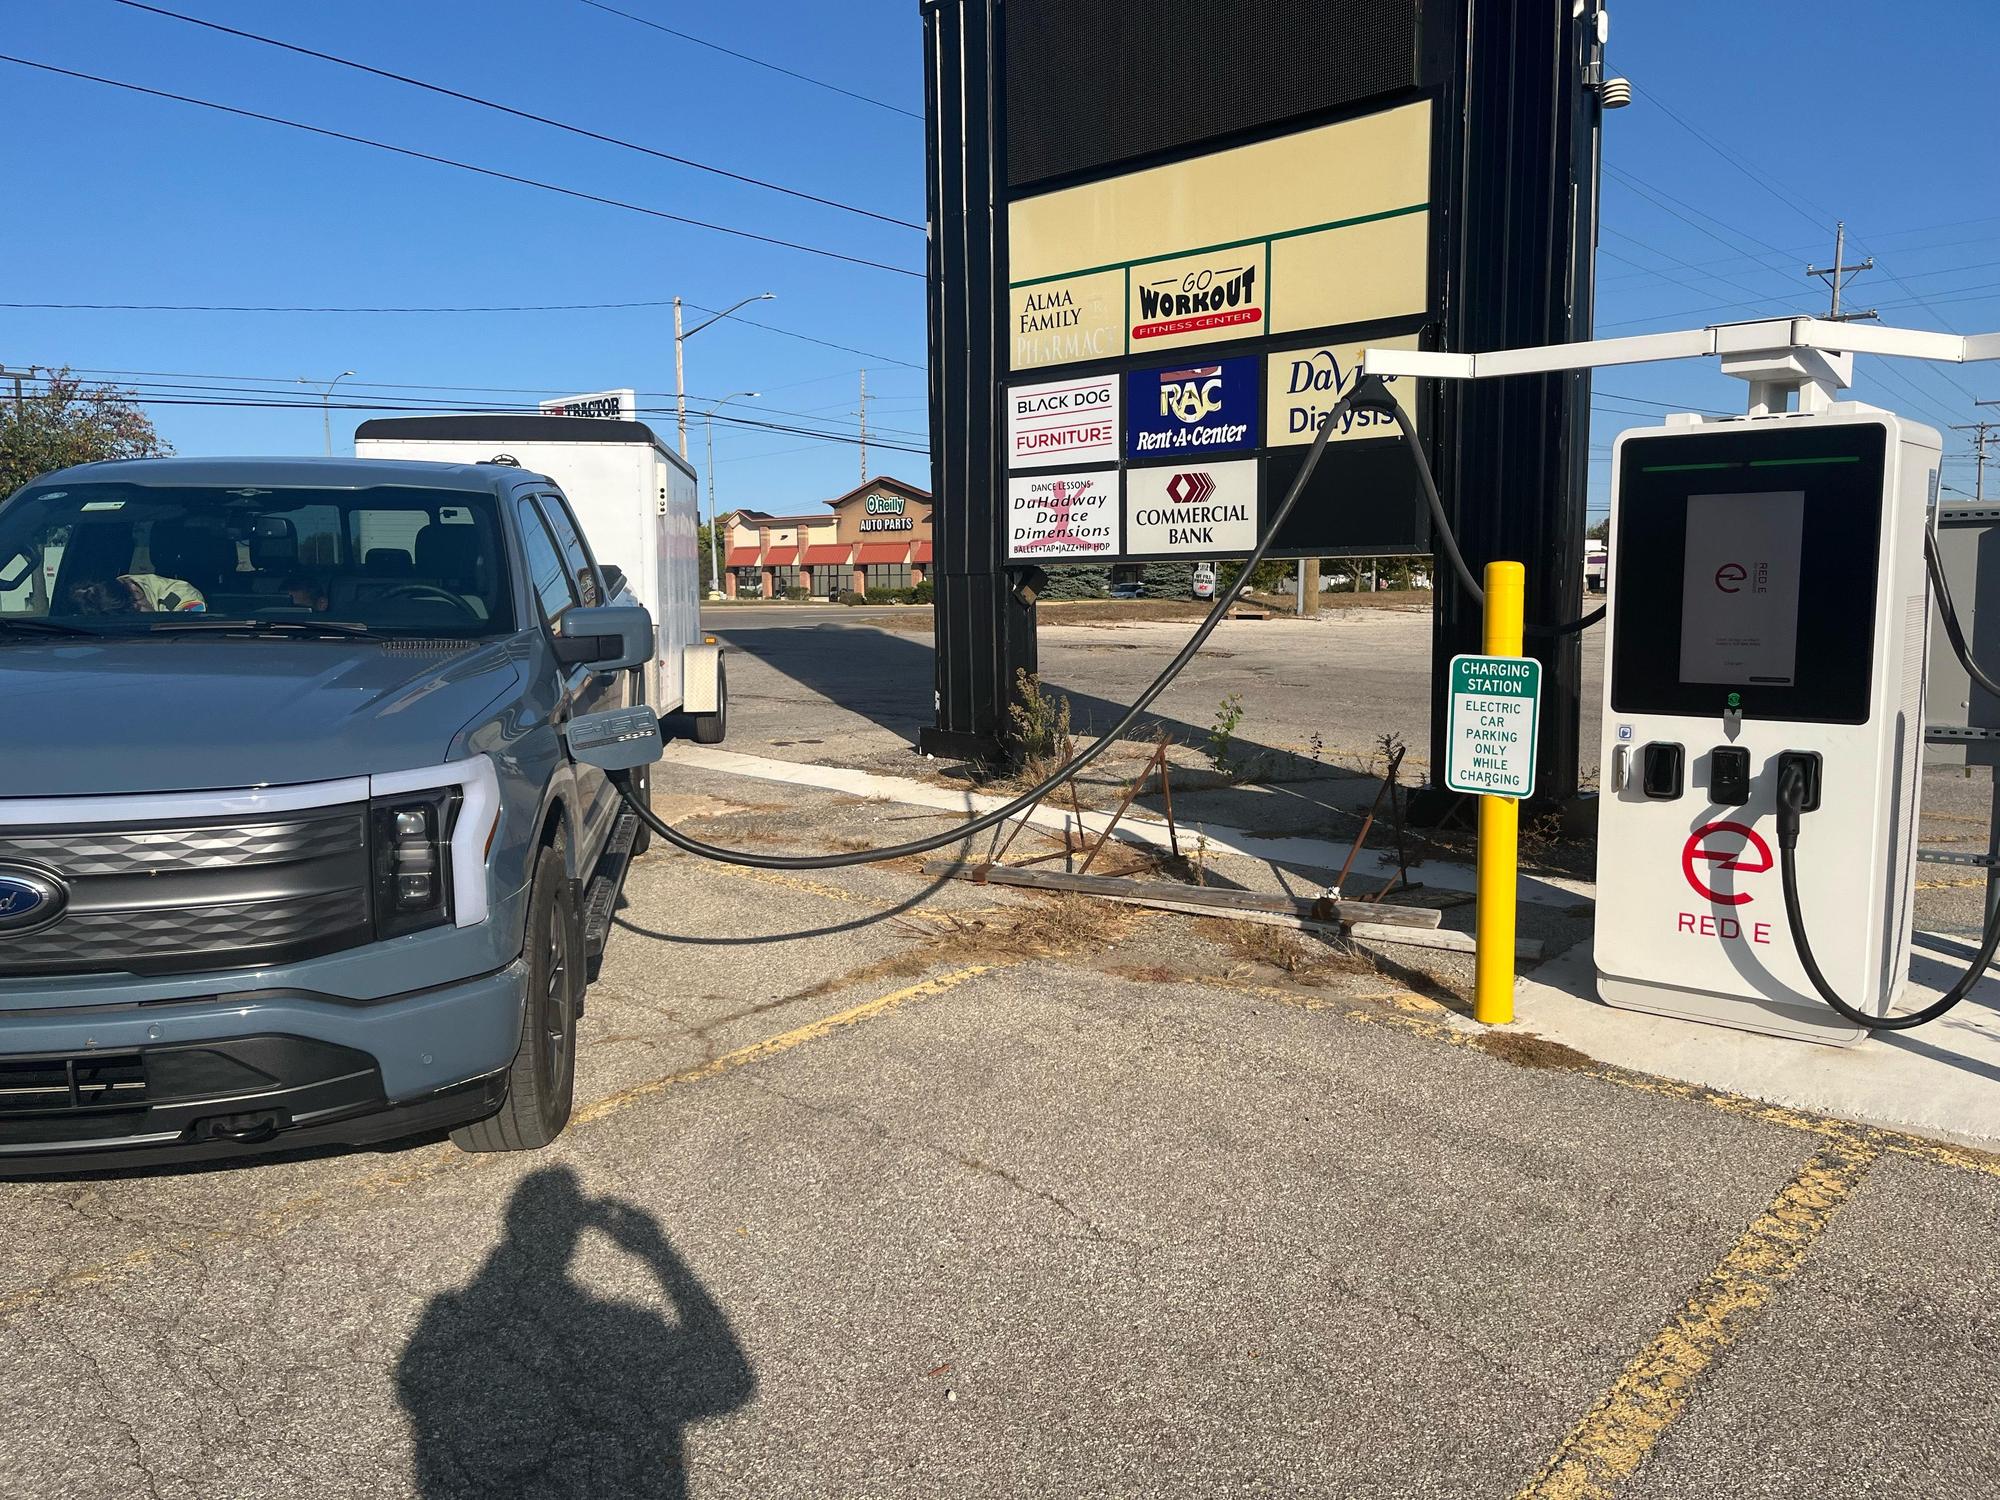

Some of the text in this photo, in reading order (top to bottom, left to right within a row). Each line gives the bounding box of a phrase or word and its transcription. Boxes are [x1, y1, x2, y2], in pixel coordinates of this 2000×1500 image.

[1182, 269, 1212, 293] GO
[1024, 289, 1073, 313] ALMA
[1139, 265, 1255, 320] WORKOUT
[1020, 308, 1082, 334] FAMILY
[1140, 312, 1251, 336] FITNESS CENTER
[564, 397, 621, 418] TRACTOR
[1017, 389, 1110, 414] BLACK DOG
[1160, 378, 1222, 424] RAC
[1017, 426, 1112, 450] FURNITURE
[866, 494, 905, 515] O'Reilly
[860, 517, 913, 531] AUTO PARTS
[1036, 511, 1088, 524] Dance
[1136, 504, 1249, 526] COMMERCIAL
[1014, 525, 1110, 540] Dimensions
[1169, 527, 1214, 544] BANK
[1461, 662, 1530, 678] CHARGING
[1467, 678, 1522, 693] STATION
[1465, 700, 1521, 714] ELECTRIC
[1480, 715, 1505, 728] CAR
[1466, 728, 1518, 743] PARKING
[1475, 743, 1507, 756] ONLY
[1473, 757, 1508, 771] WHILE
[1460, 769, 1520, 786] CHARGING
[1678, 912, 1772, 944] RED E
